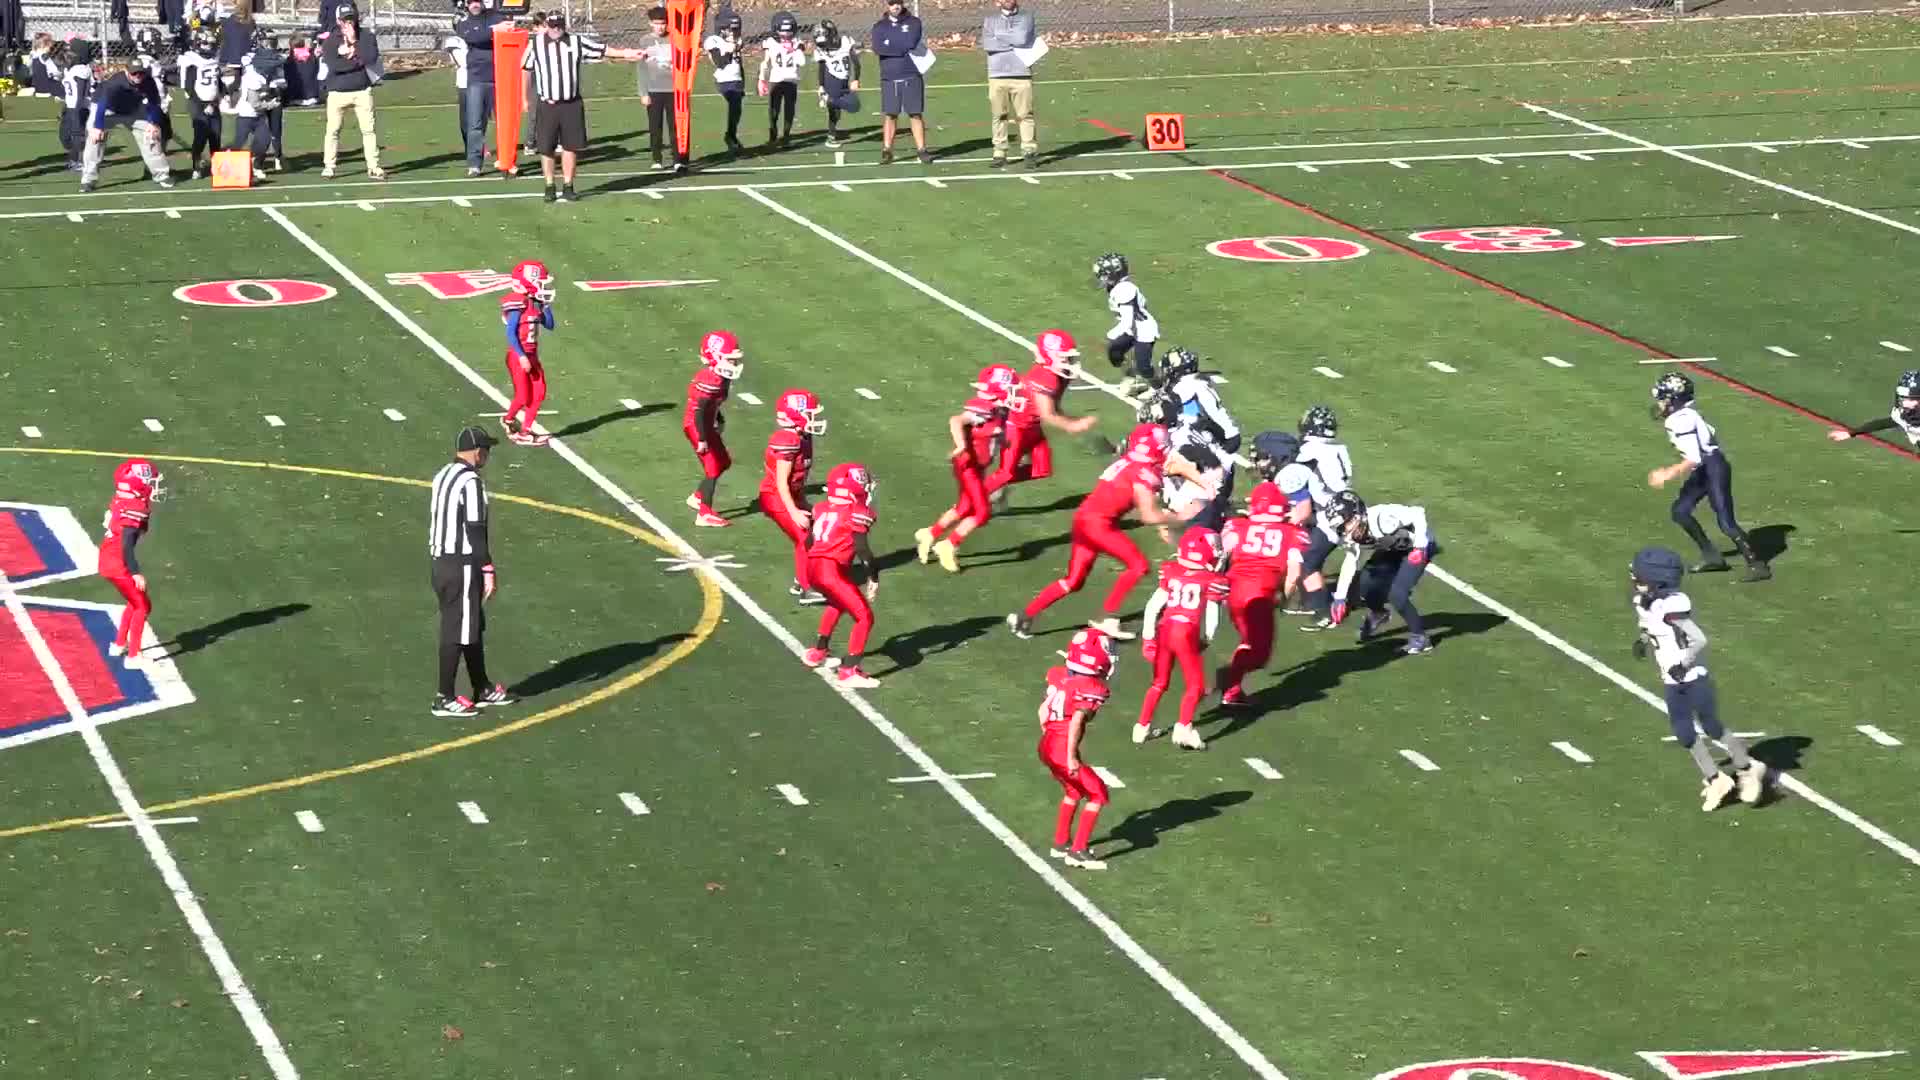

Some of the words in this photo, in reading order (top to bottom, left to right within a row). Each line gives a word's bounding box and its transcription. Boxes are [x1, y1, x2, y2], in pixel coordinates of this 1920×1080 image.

[1151, 118, 1180, 145] 30
[1241, 524, 1284, 558] 59
[1167, 578, 1202, 611] 30
